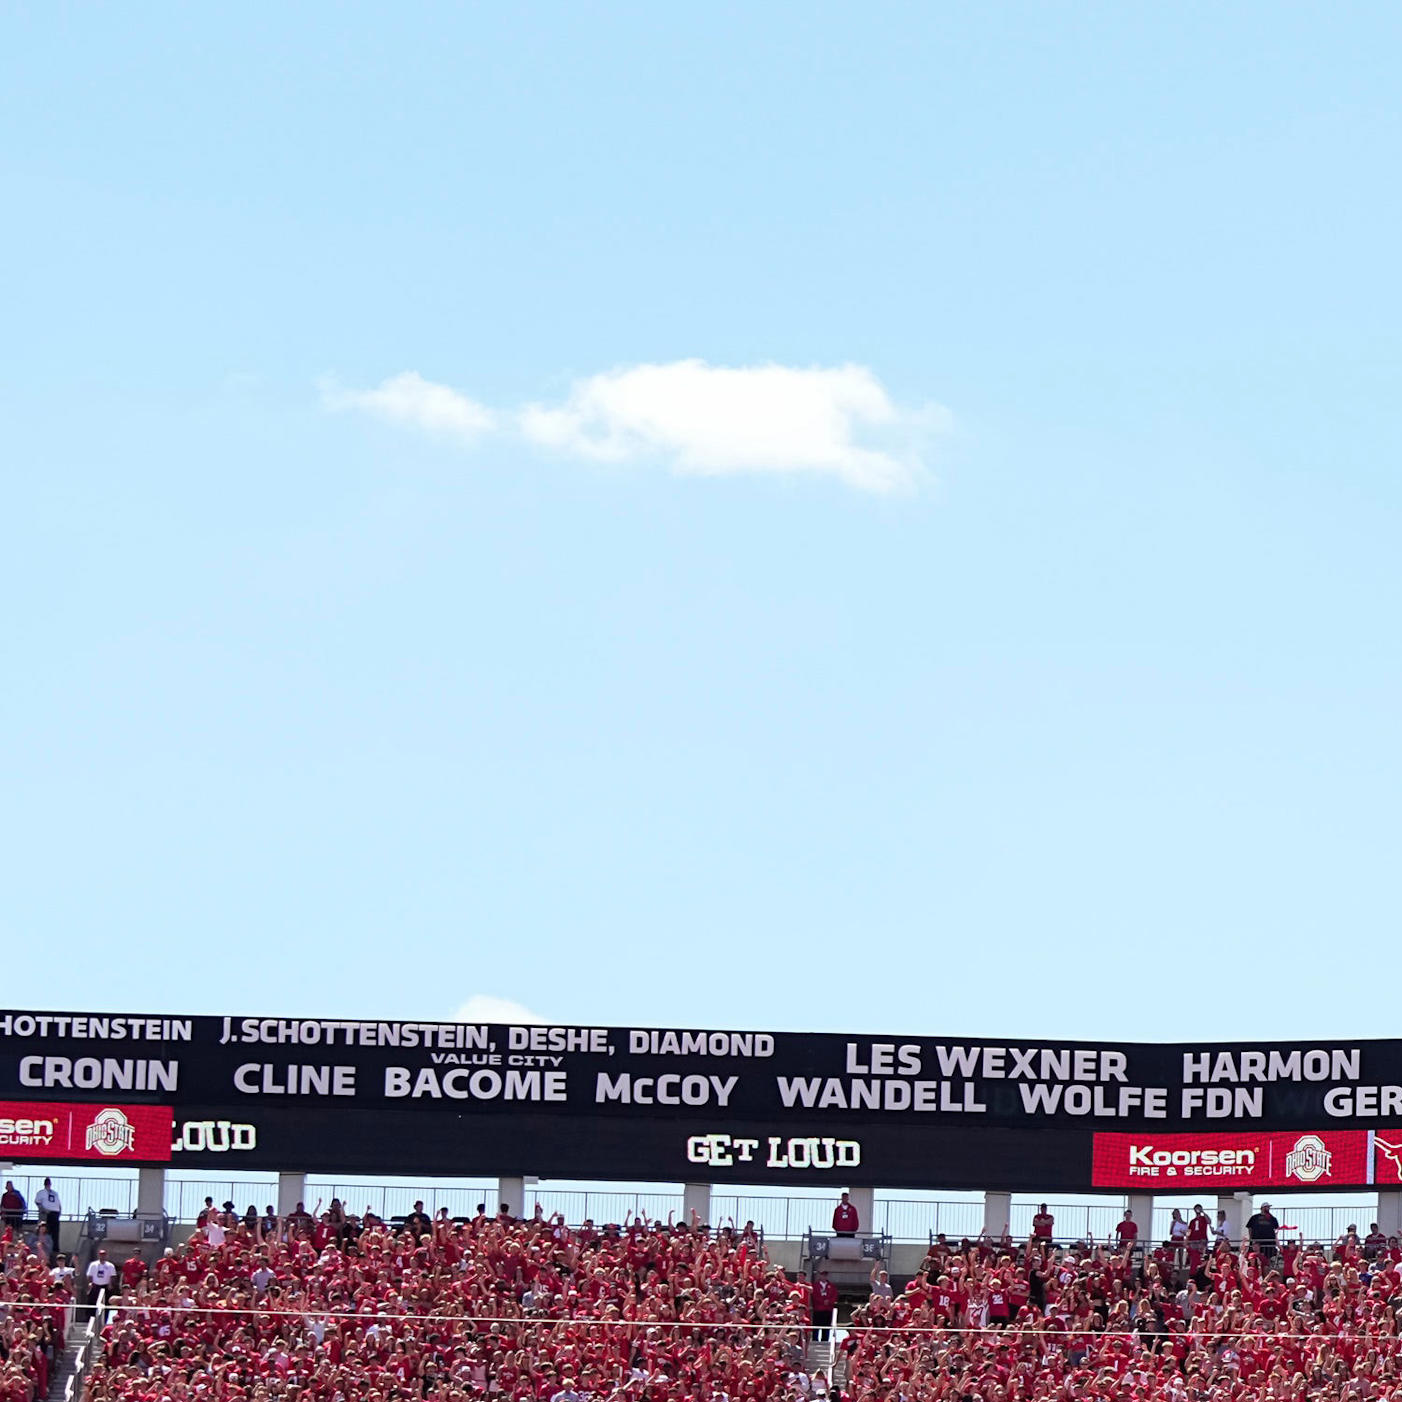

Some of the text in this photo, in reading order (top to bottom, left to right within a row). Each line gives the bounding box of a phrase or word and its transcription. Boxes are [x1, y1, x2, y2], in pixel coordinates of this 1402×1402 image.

[431, 1052, 564, 1068] VALUE CITY
[508, 1027, 616, 1055] DESHE,
[629, 1030, 775, 1058] DIAMOND
[19, 1055, 179, 1091] CRONIN
[234, 1062, 356, 1097] CLINE
[845, 1042, 1128, 1083] LES WEXNER
[1183, 1048, 1361, 1084] HARMON
[384, 1066, 567, 1101] BACOME
[595, 1072, 738, 1107] McCOY
[776, 1075, 987, 1113] WANDELL
[1018, 1082, 1264, 1119] WOLFE FDN
[687, 1134, 861, 1168] GET LOUD
[1129, 1145, 1255, 1166] Koorsen
[1129, 1165, 1255, 1176] FIRE & SECURITY
